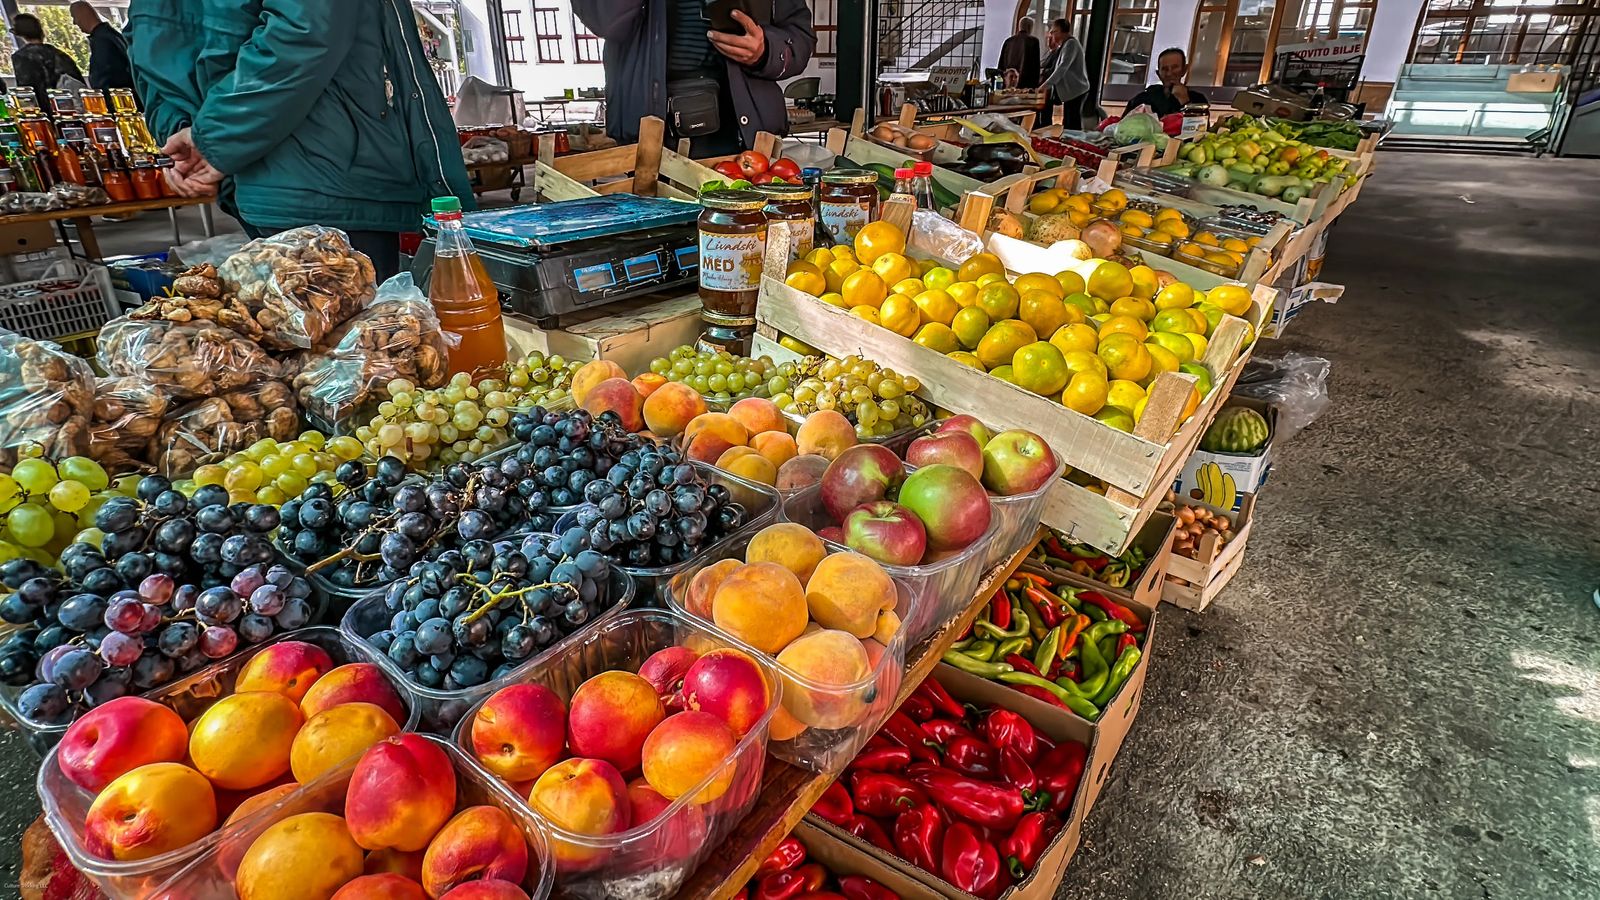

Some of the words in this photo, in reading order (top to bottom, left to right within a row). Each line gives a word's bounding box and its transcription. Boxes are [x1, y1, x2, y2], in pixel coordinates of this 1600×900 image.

[1333, 44, 1361, 55] BILJE
[706, 238, 757, 252] Livadski
[702, 255, 735, 272] MED
